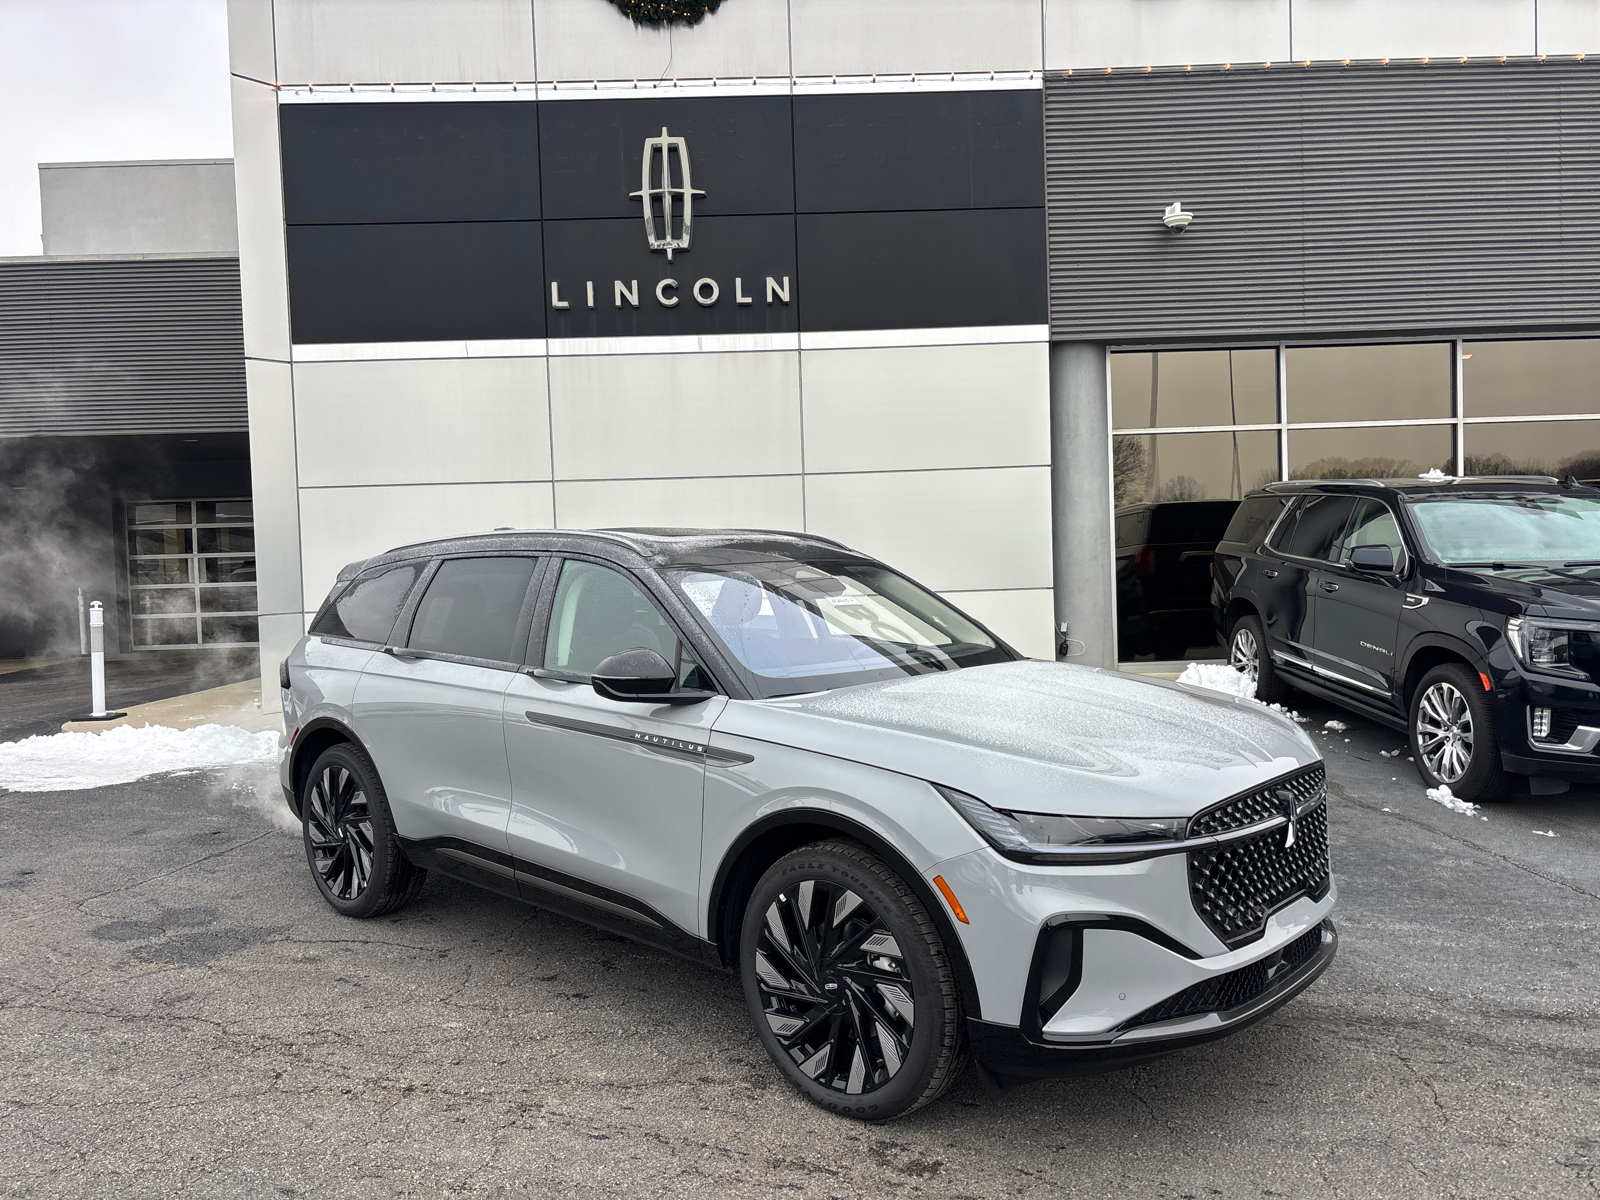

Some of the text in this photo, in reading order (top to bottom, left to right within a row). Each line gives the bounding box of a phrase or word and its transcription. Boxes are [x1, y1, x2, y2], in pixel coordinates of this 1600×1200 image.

[551, 276, 790, 310] LINCOLN
[1360, 640, 1394, 657] DENALI
[634, 733, 703, 752] NAUTILUS
[781, 863, 892, 915] EAGLE TOURING
